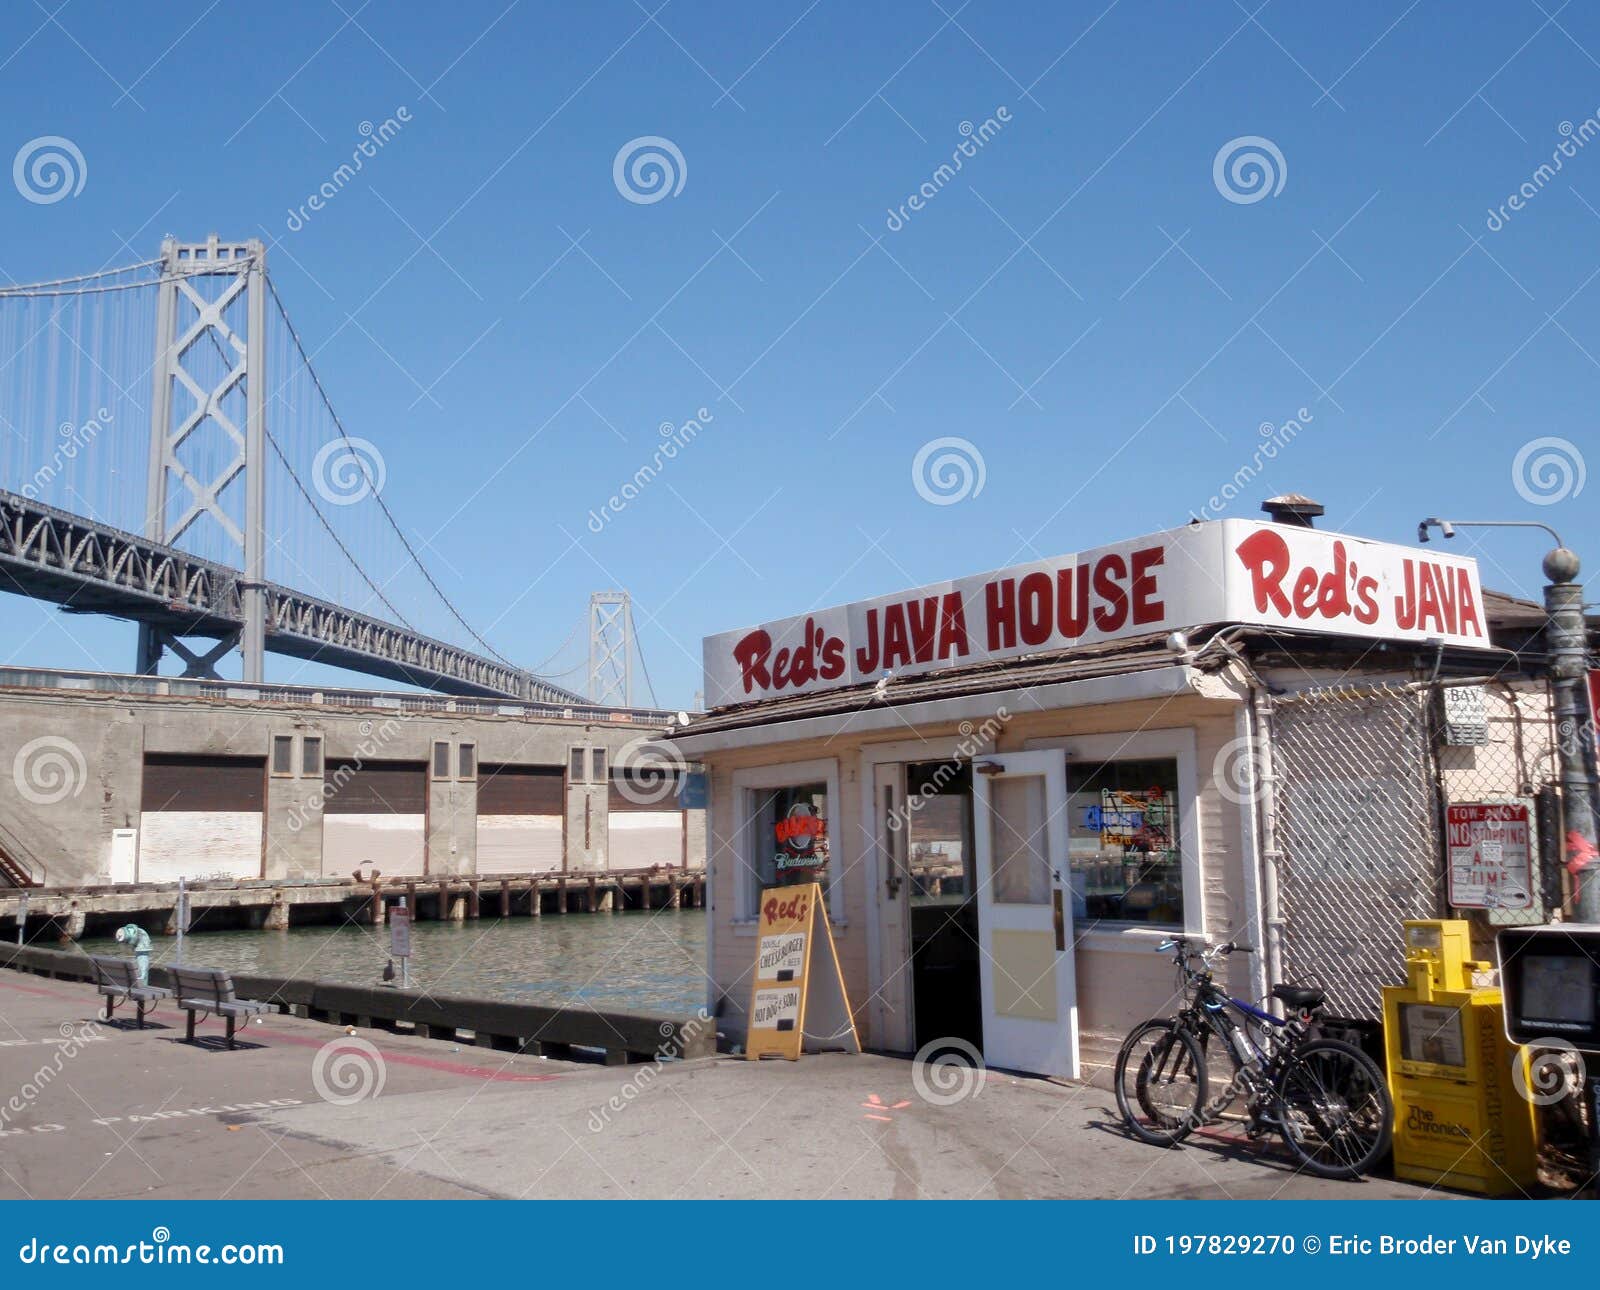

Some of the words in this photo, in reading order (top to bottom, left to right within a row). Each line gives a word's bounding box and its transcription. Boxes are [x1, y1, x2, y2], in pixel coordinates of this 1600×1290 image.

[1235, 529, 1379, 625] Red's
[1394, 559, 1482, 637] JAVA
[733, 617, 845, 694] Red's
[856, 590, 970, 675] JAVA
[985, 546, 1165, 651] HOUSE
[1450, 822, 1471, 845] NO
[764, 894, 807, 926] Red's
[92, 1098, 303, 1125] PARKING
[1408, 1104, 1434, 1121] The
[1407, 1117, 1471, 1137] Chronicle
